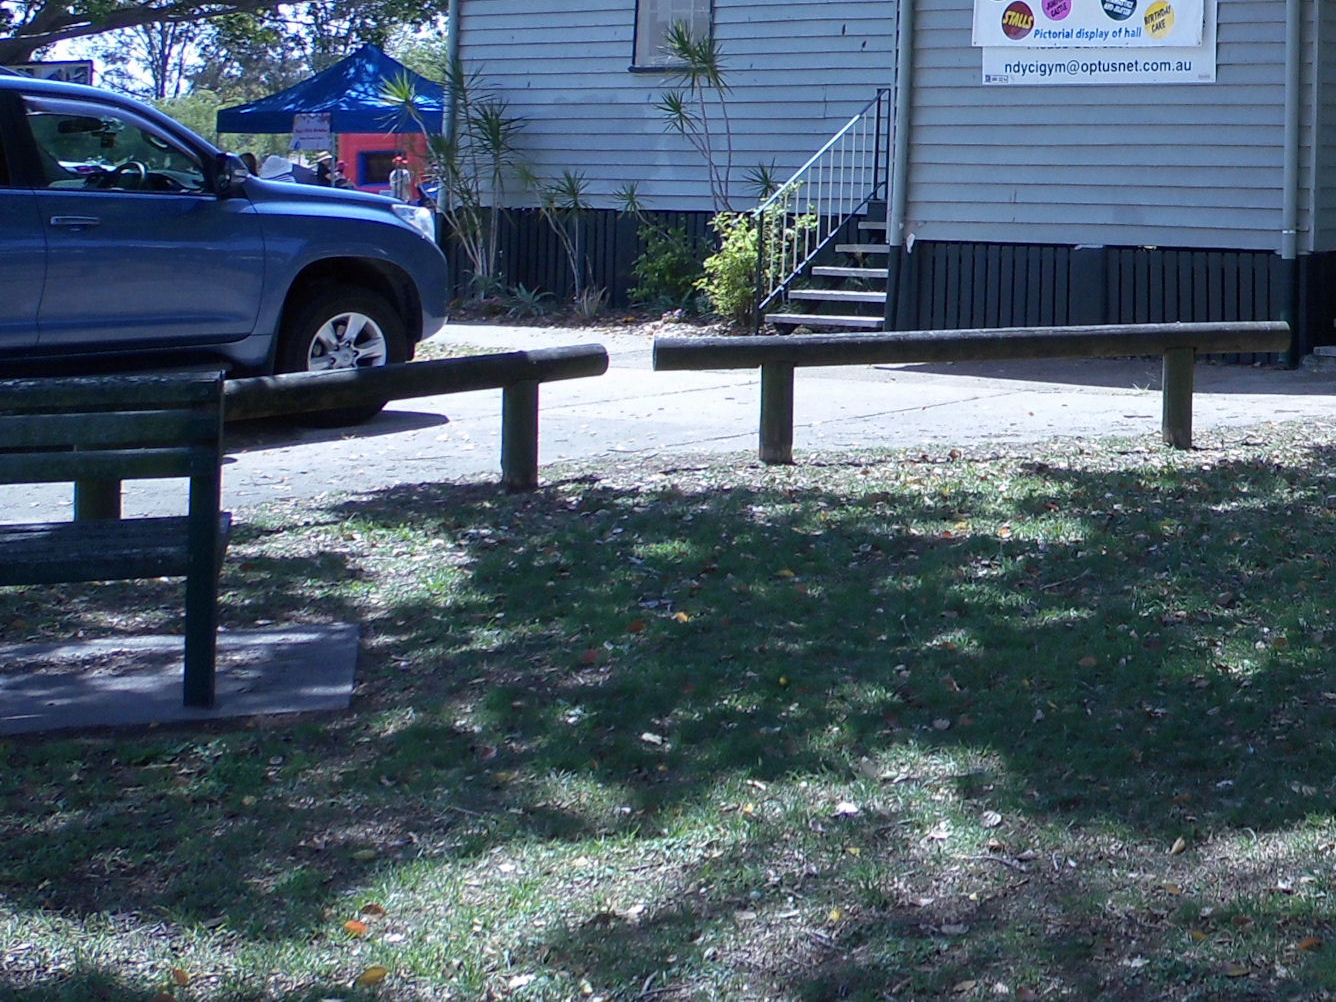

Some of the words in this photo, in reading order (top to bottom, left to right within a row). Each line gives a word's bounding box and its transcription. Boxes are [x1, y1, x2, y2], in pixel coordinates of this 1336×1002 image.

[1003, 10, 1034, 29] STALLS
[1144, 4, 1171, 25] BIRTHDAY
[1033, 28, 1073, 39] Pictorial
[1075, 29, 1110, 41] display
[1112, 27, 1123, 38] of
[1124, 27, 1141, 38] hall
[1151, 18, 1166, 33] CAKE
[1004, 60, 1192, 77] ndycigym@optusnet.com.au
